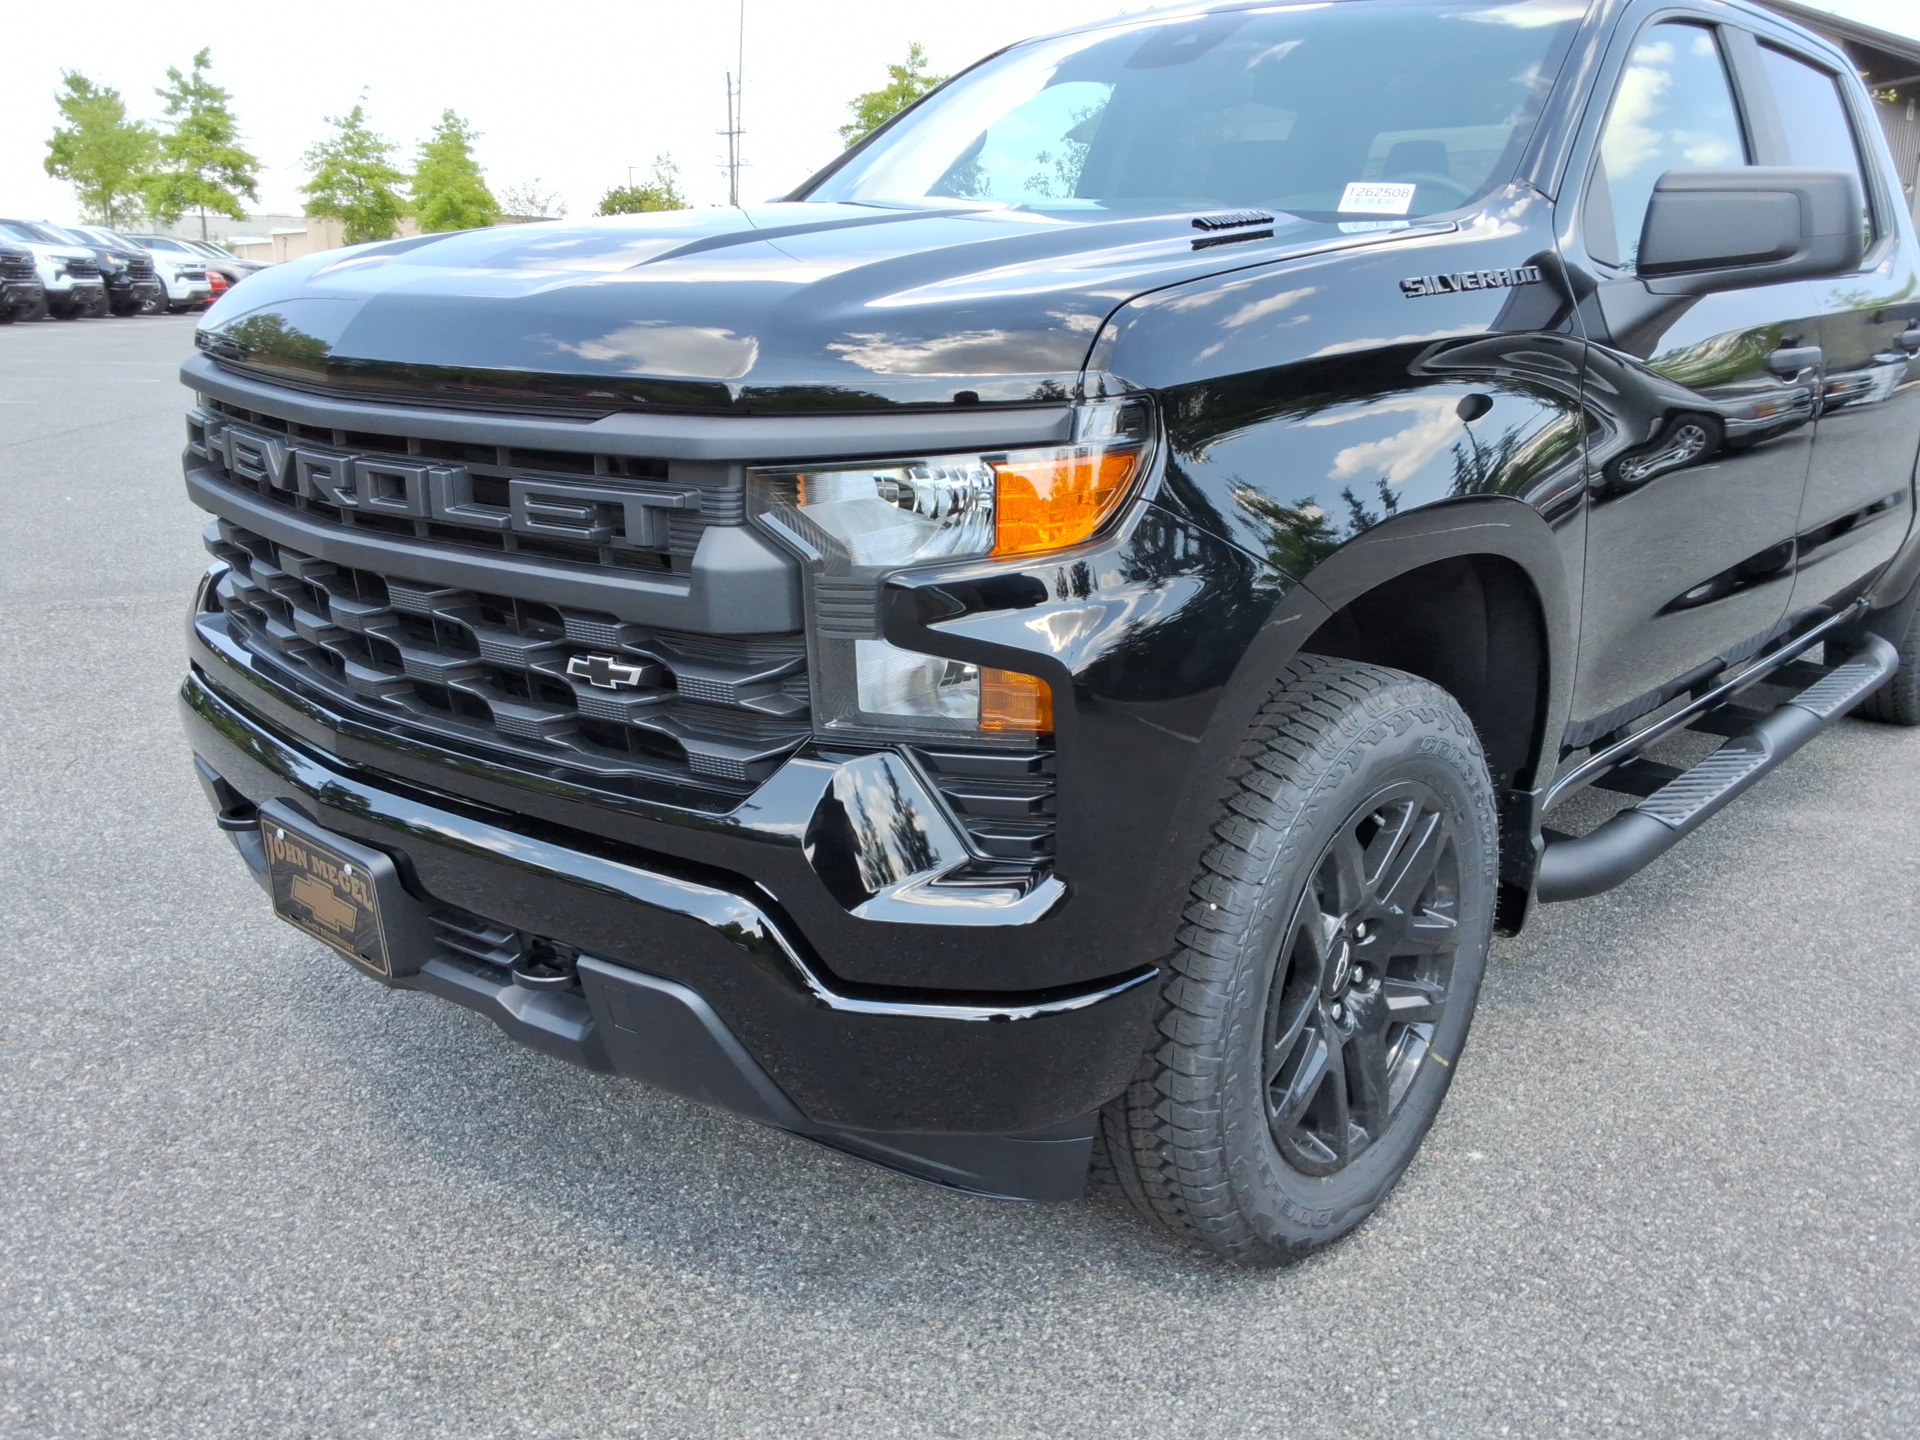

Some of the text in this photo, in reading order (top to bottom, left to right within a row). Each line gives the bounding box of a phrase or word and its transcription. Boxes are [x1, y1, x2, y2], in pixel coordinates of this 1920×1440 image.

[1349, 187, 1410, 198] T262508
[1400, 266, 1542, 299] SILVERADO
[186, 409, 700, 547] CHEVROLET
[266, 832, 374, 913] JOHN MEGEL
